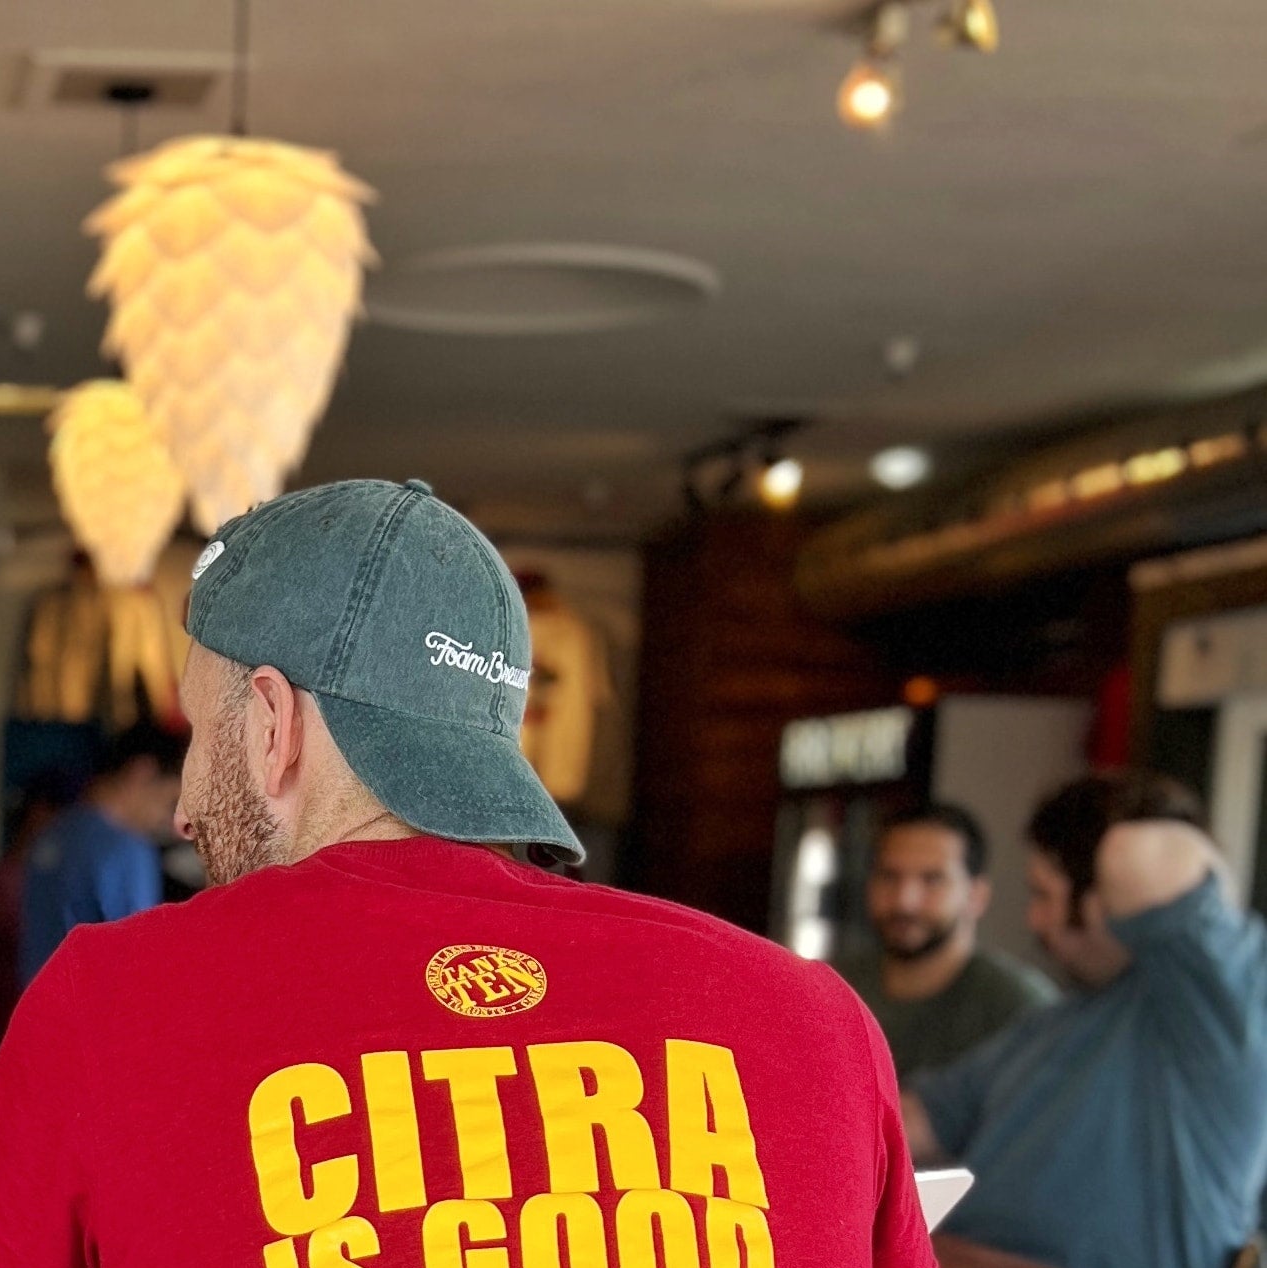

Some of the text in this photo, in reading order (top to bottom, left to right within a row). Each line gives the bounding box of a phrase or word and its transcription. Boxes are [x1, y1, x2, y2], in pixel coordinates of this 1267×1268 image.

[425, 631, 489, 676] Foam
[441, 950, 519, 984] TANK
[444, 960, 542, 1010] TEN
[248, 1038, 770, 1237] CITRA
